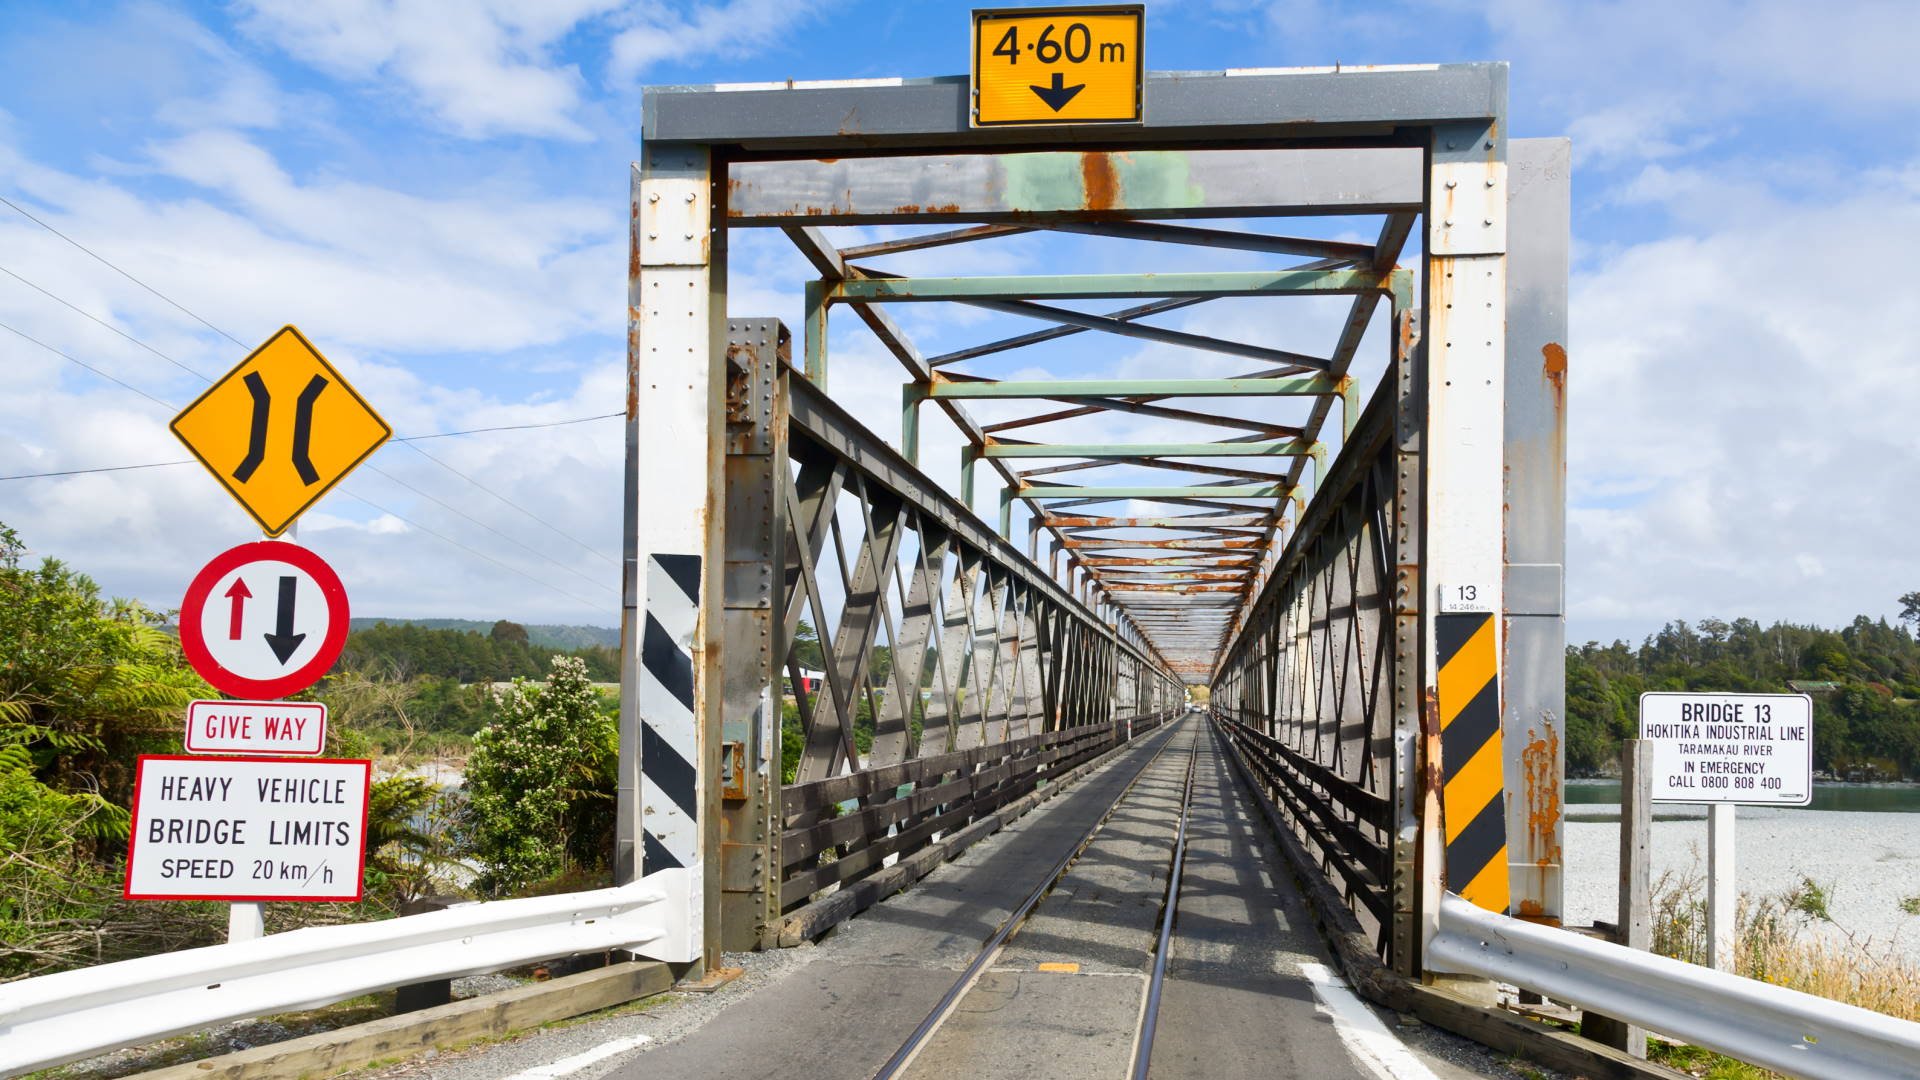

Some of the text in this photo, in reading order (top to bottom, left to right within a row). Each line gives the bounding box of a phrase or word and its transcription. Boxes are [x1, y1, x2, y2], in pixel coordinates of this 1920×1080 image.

[1100, 42, 1125, 62] m
[1458, 585, 1476, 600] 13
[1681, 703, 1771, 723] BRIDGE 13
[205, 715, 307, 741] GIVE WAY
[1646, 723, 1805, 741] HOKITIKA INDUSTRIAL LINE
[1678, 743, 1773, 756] TARAMAKAU RIVER
[1684, 761, 1765, 774] IN EMERGENCY
[160, 776, 346, 804] HEAVY VEHICLE
[1669, 775, 1781, 789] CALL 0800 808 400
[148, 818, 350, 847] BRIDGE LIMITS
[160, 858, 333, 888] SPEED 20 km/h
